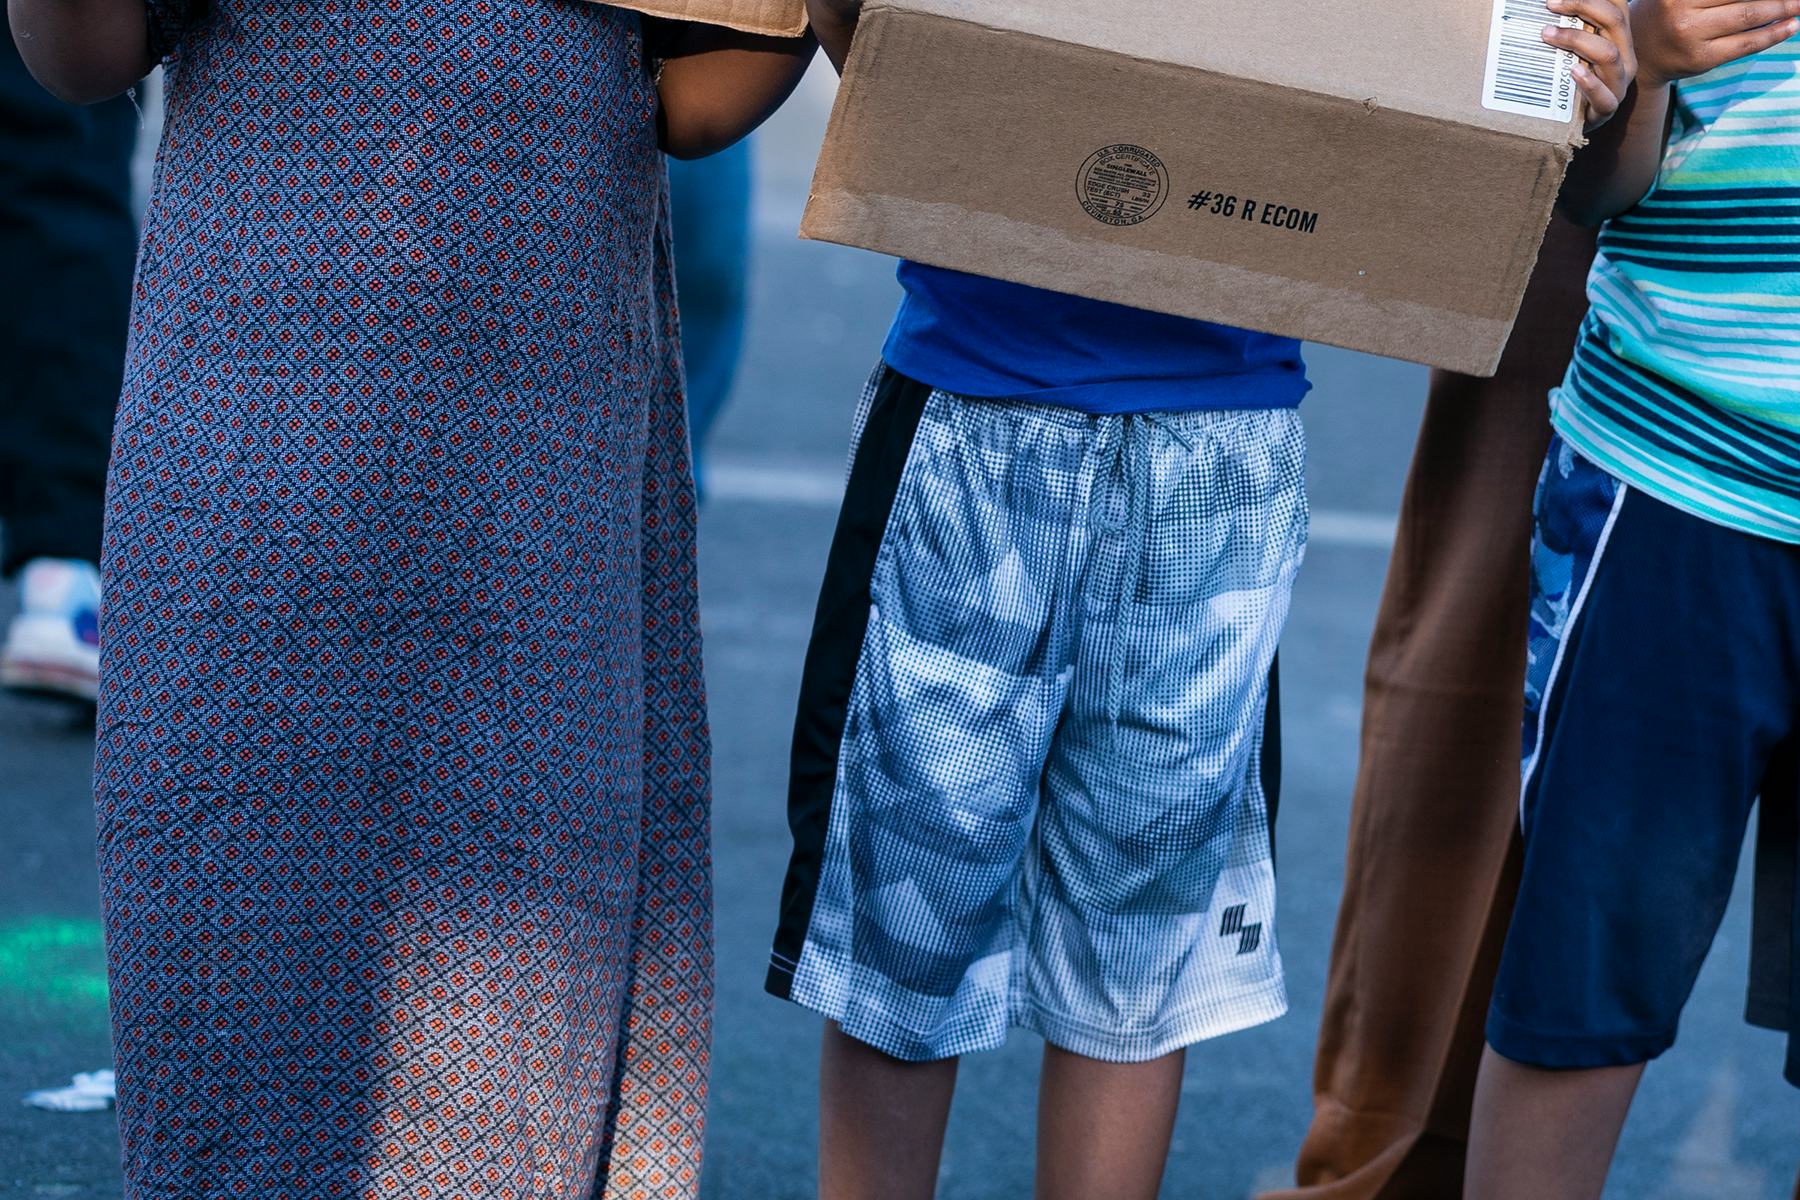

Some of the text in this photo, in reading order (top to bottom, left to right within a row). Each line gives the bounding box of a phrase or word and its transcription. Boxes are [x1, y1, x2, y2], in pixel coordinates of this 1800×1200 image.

[1112, 145, 1160, 168] CORRUGATED
[1115, 153, 1155, 176] CERTIFICATE
[1187, 191, 1318, 233] #36 R ECOM
